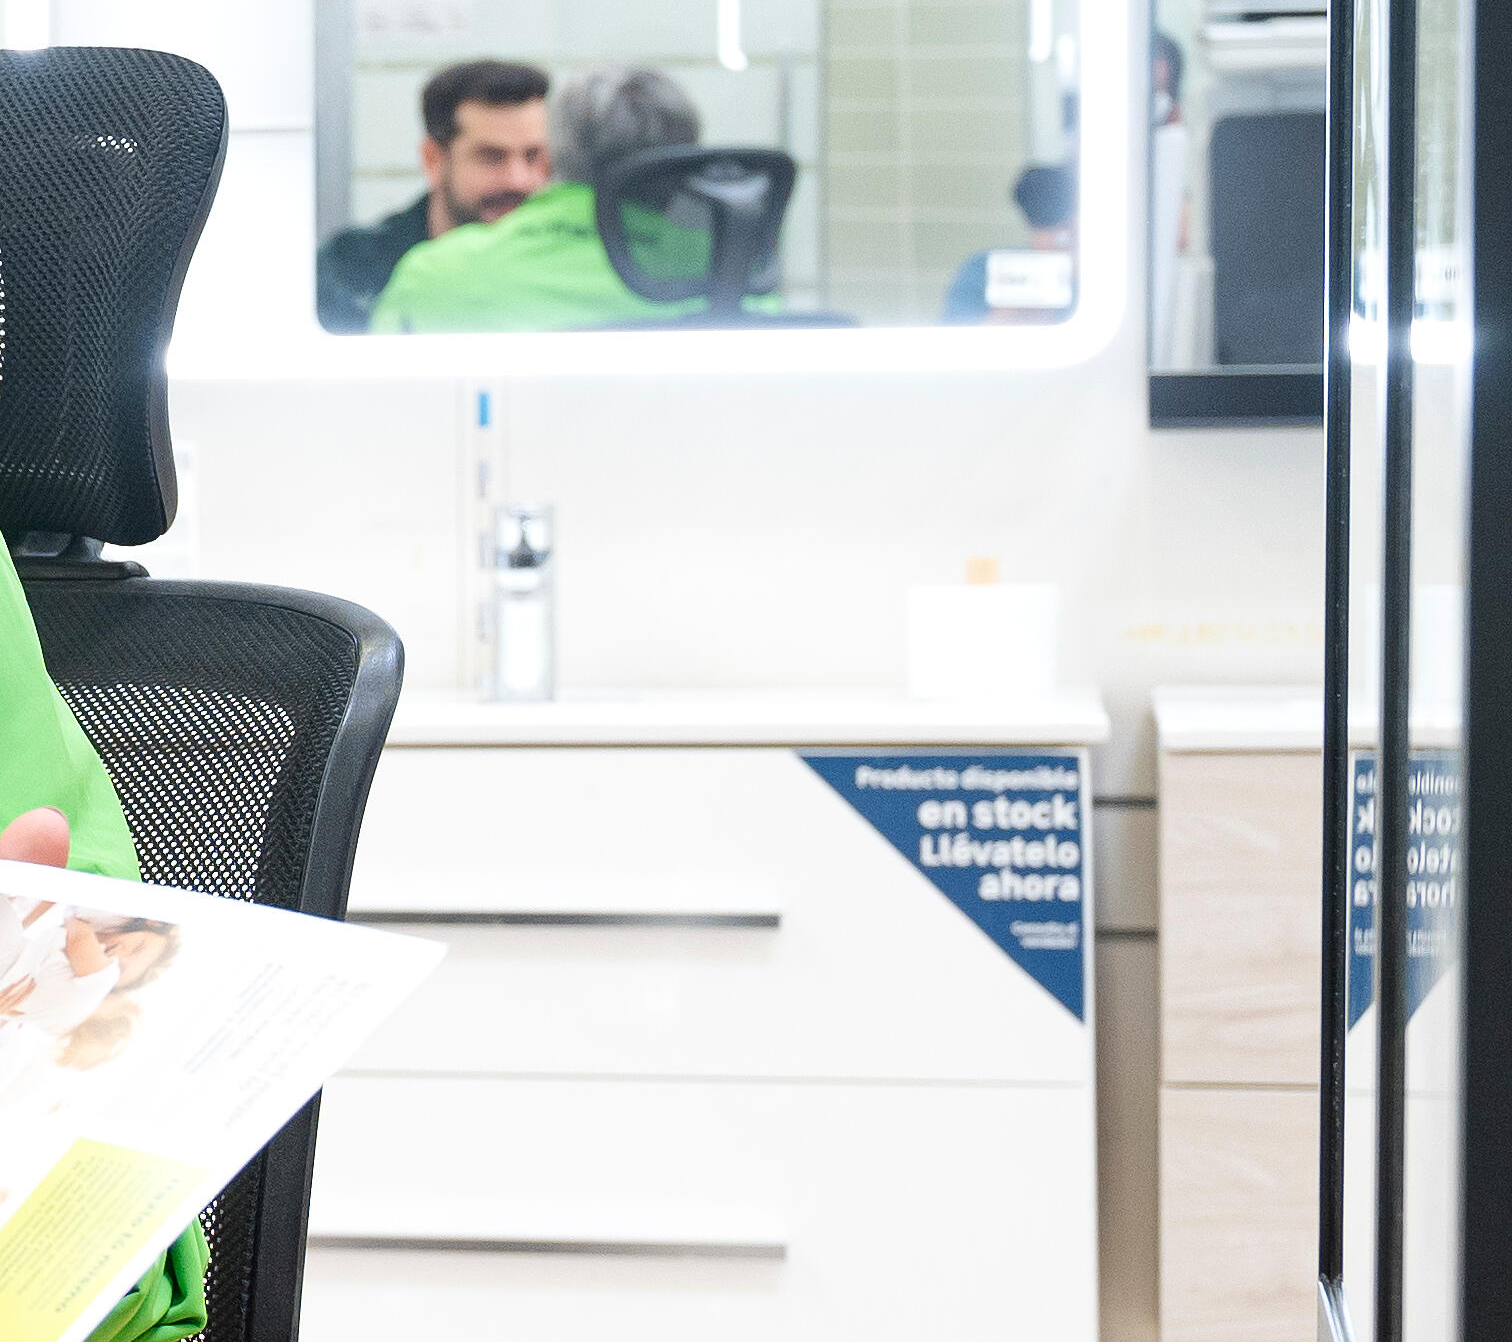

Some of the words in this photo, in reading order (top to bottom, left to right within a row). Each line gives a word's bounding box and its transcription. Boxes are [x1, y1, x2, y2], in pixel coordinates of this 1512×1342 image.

[917, 800, 968, 830] en
[972, 794, 1078, 830] stock
[920, 832, 1080, 869] Llévatelo
[978, 868, 1080, 902] ahora
